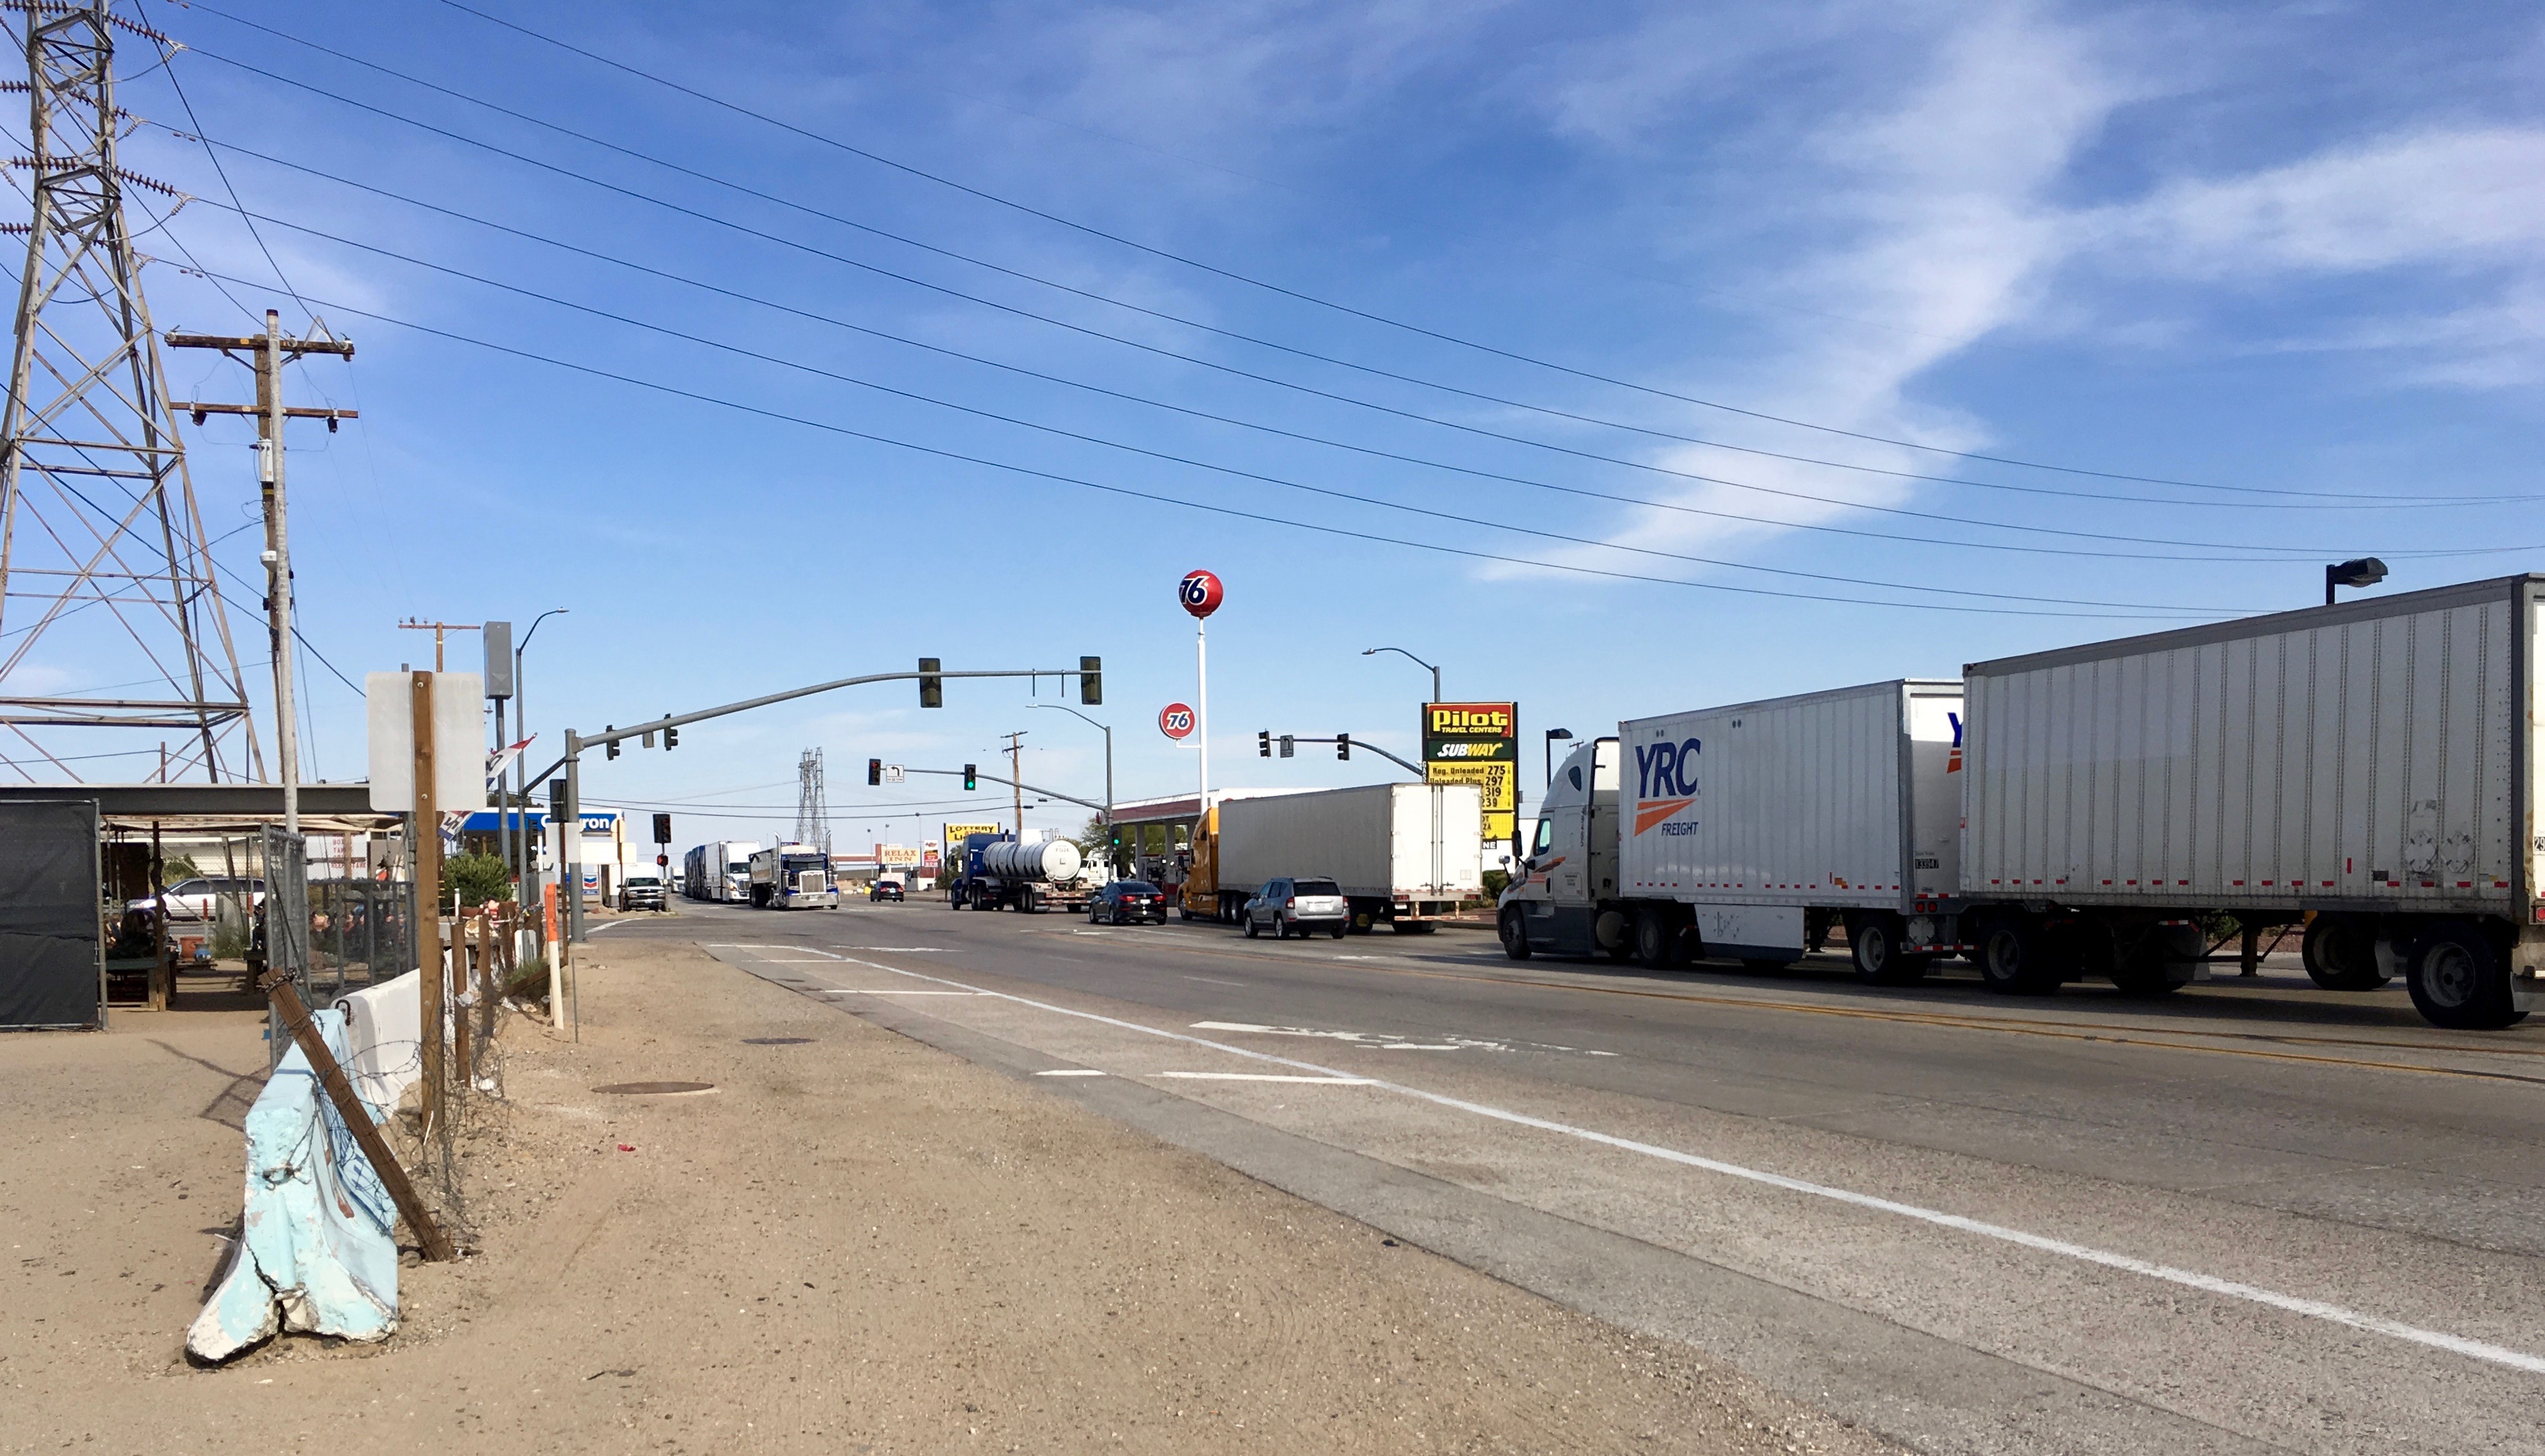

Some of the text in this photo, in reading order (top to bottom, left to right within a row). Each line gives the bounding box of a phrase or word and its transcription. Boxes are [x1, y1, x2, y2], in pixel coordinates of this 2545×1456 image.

[1179, 576, 1210, 605] 76
[1166, 711, 1191, 730] 76
[1433, 710, 1508, 731] Pilot
[1437, 743, 1503, 757] SUBWAY
[1487, 766, 1506, 775] 275
[1635, 738, 1700, 798] YRC
[1485, 776, 1504, 786] 297
[1485, 787, 1501, 796] 319
[1662, 822, 1698, 836] FREIGHT
